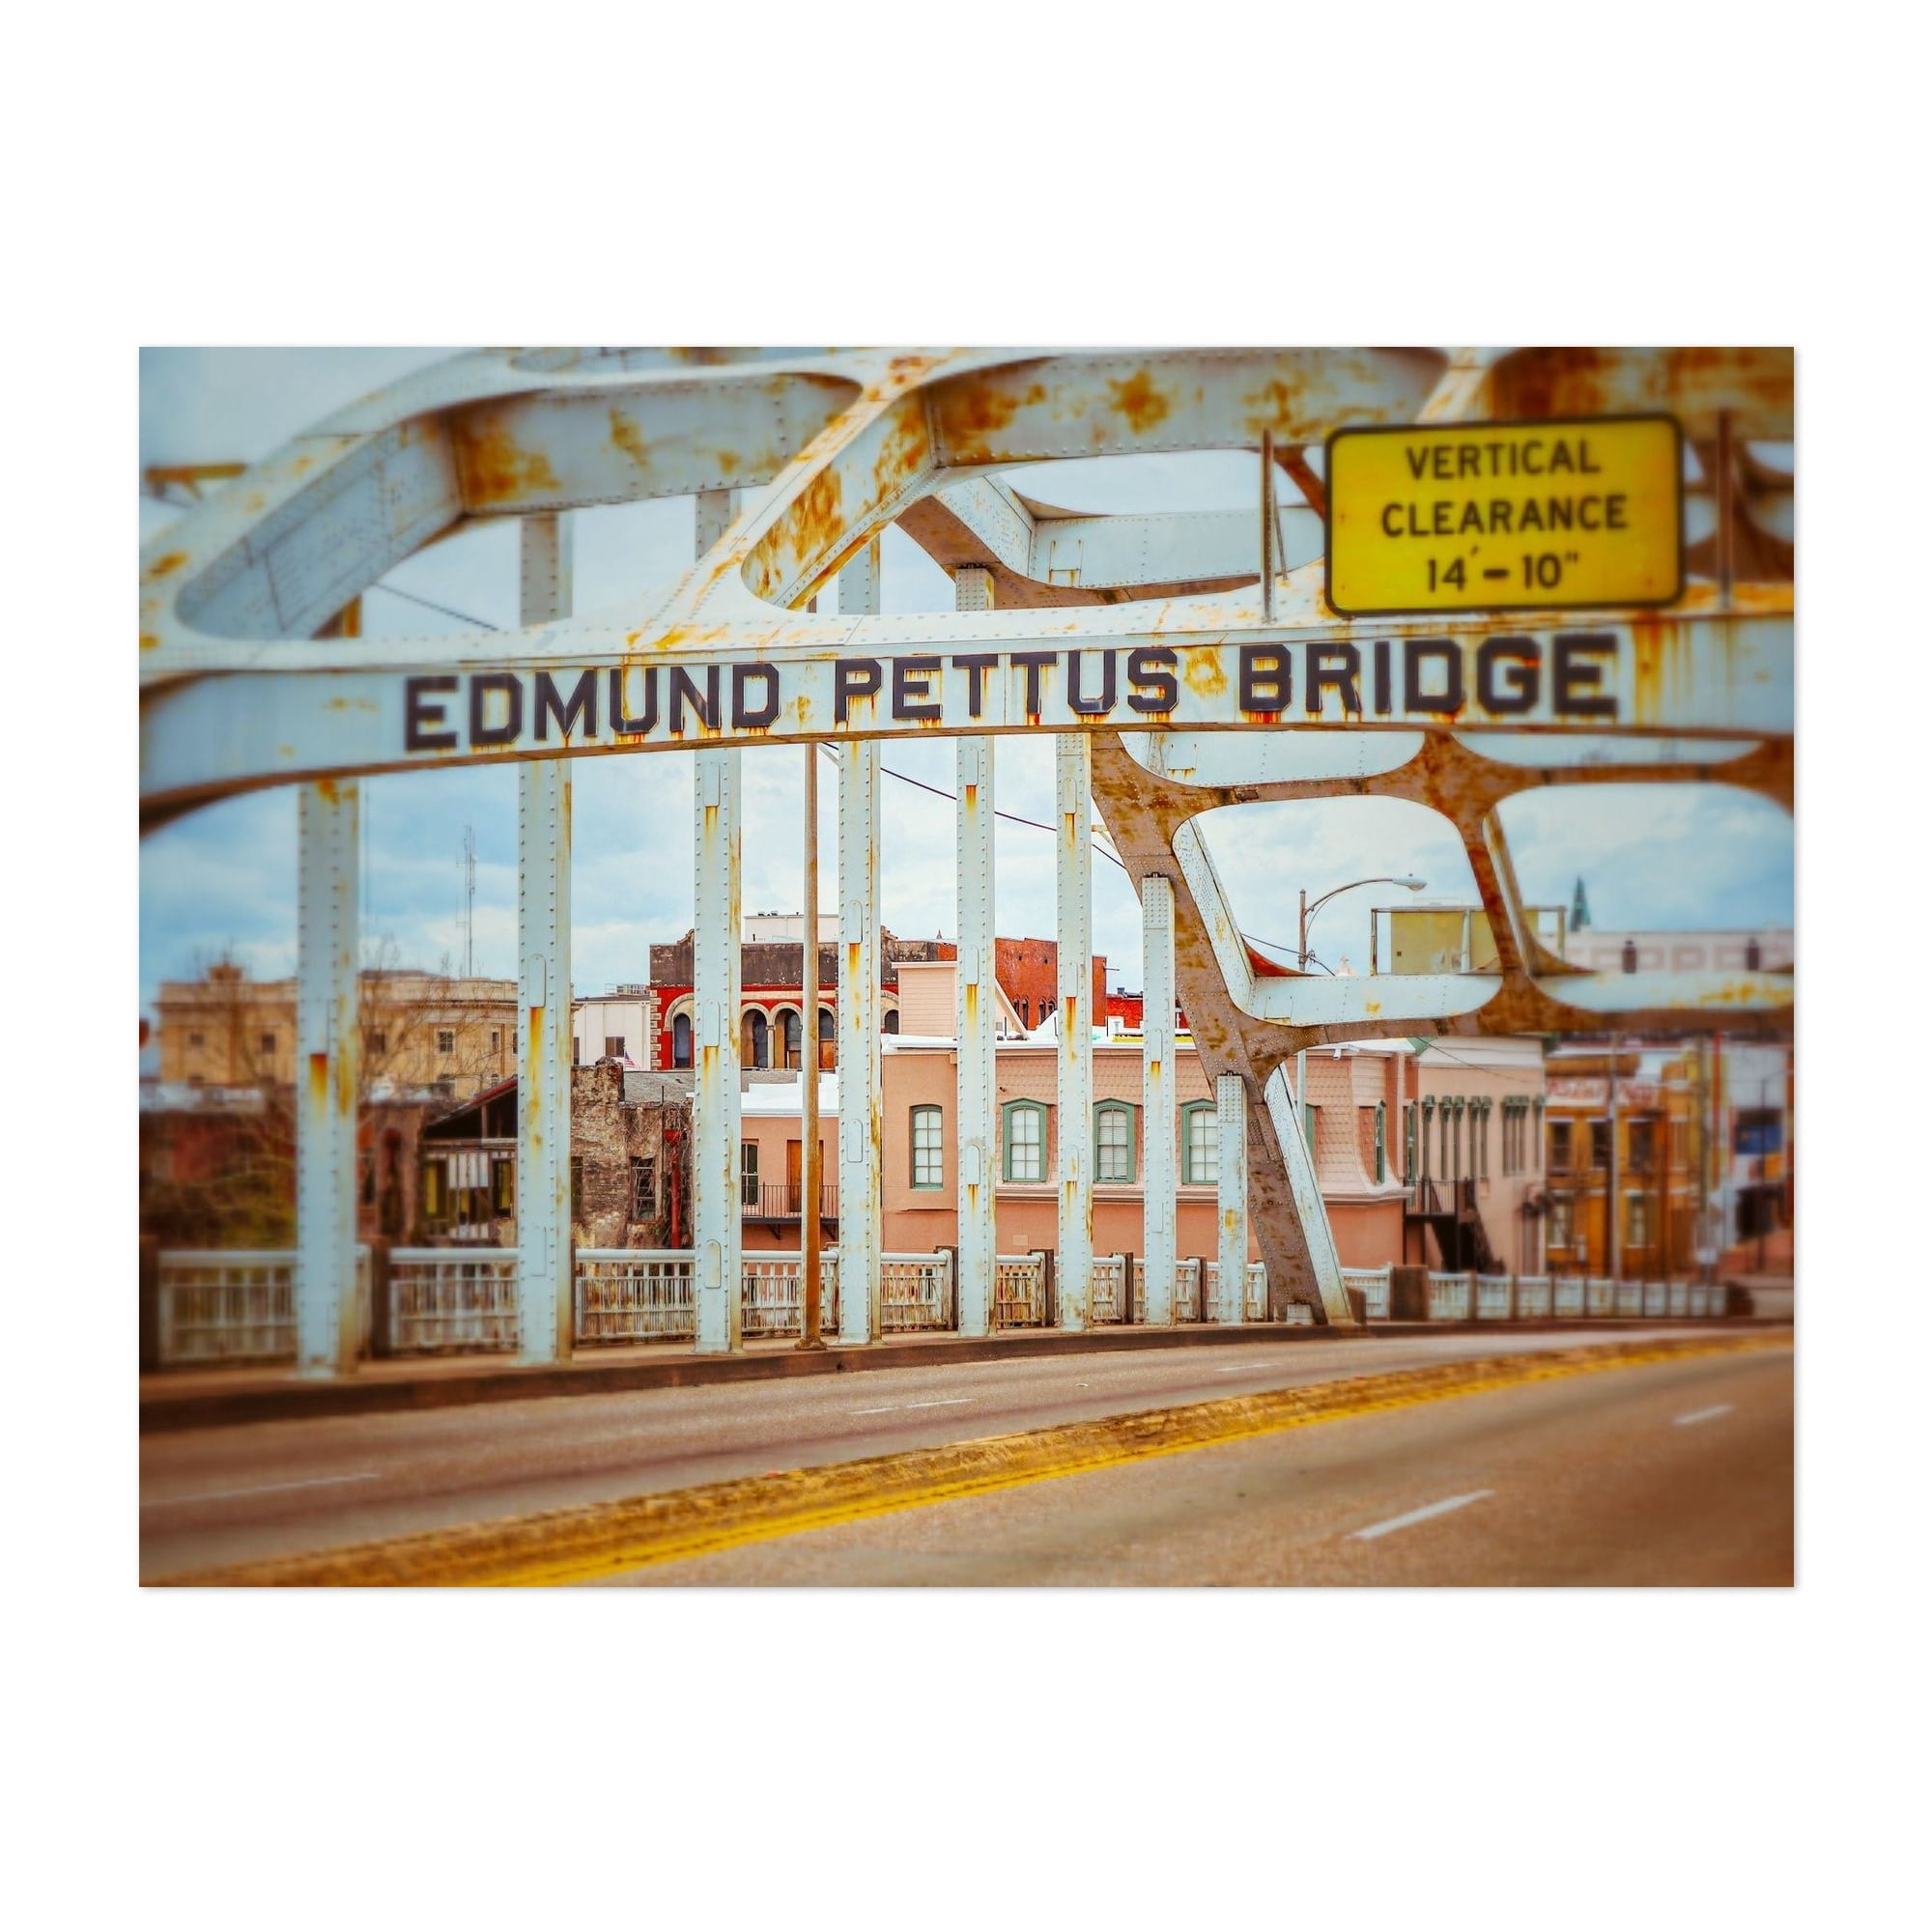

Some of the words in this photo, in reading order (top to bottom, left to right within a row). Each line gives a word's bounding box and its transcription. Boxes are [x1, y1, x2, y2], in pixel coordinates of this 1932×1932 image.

[1406, 439, 1601, 480] VERTICAL
[1381, 494, 1628, 538] CLEARANCE
[405, 663, 781, 751] EDMUND
[835, 647, 1179, 723] PETTUS
[1238, 633, 1618, 715] BRIDGE
